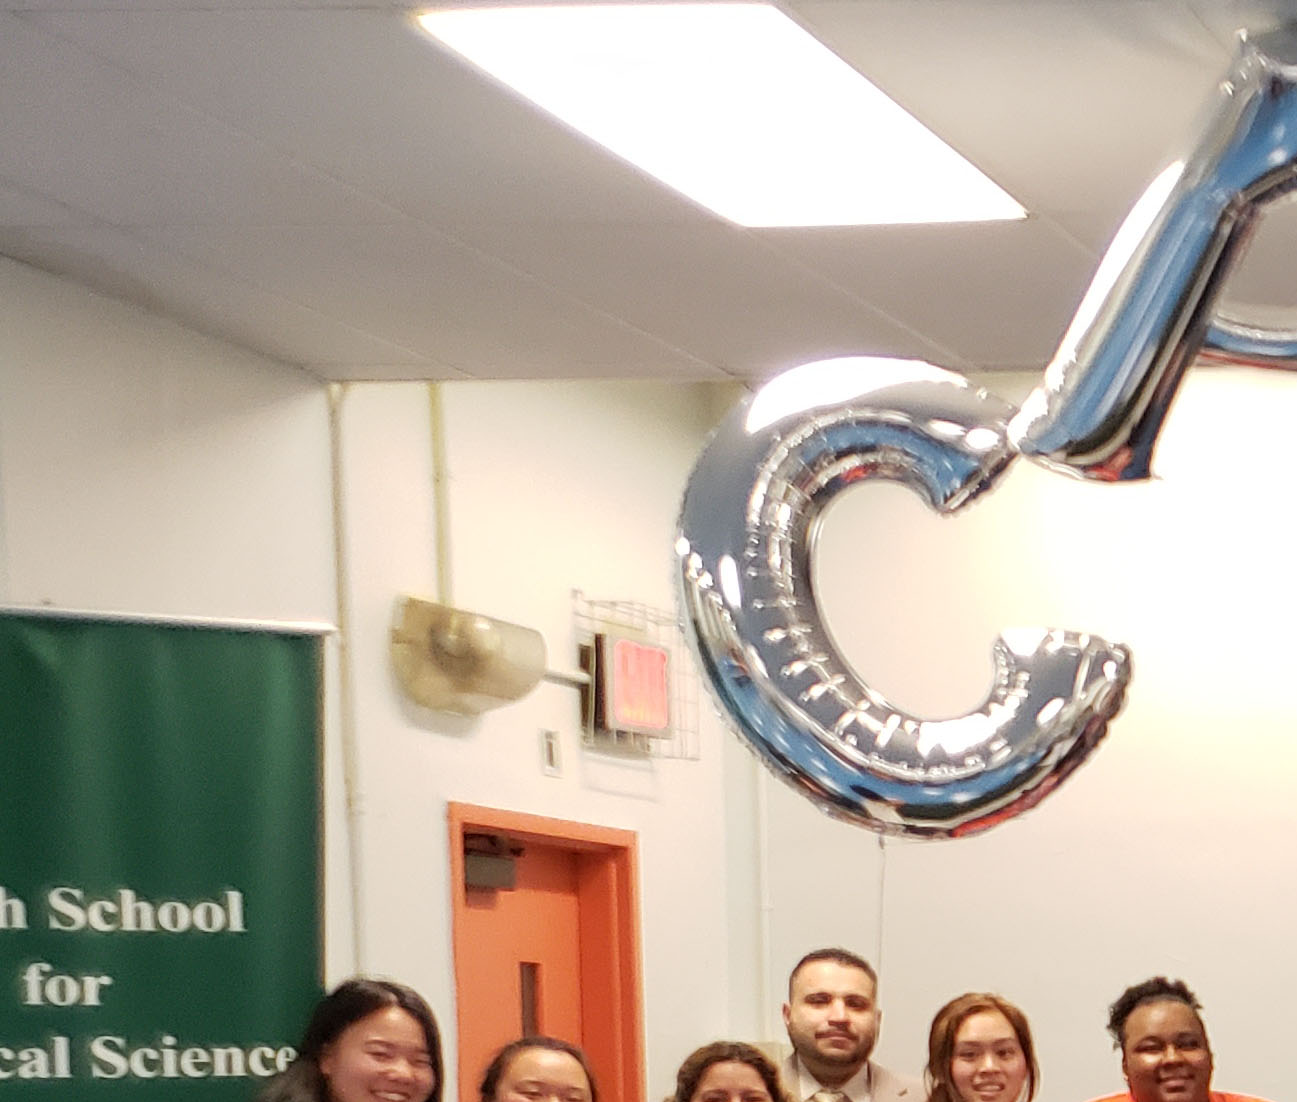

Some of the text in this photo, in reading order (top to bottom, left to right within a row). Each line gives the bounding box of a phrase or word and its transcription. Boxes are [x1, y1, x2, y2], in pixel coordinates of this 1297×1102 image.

[48, 886, 247, 932] School
[22, 962, 113, 1006] for
[91, 1035, 297, 1079] Science
